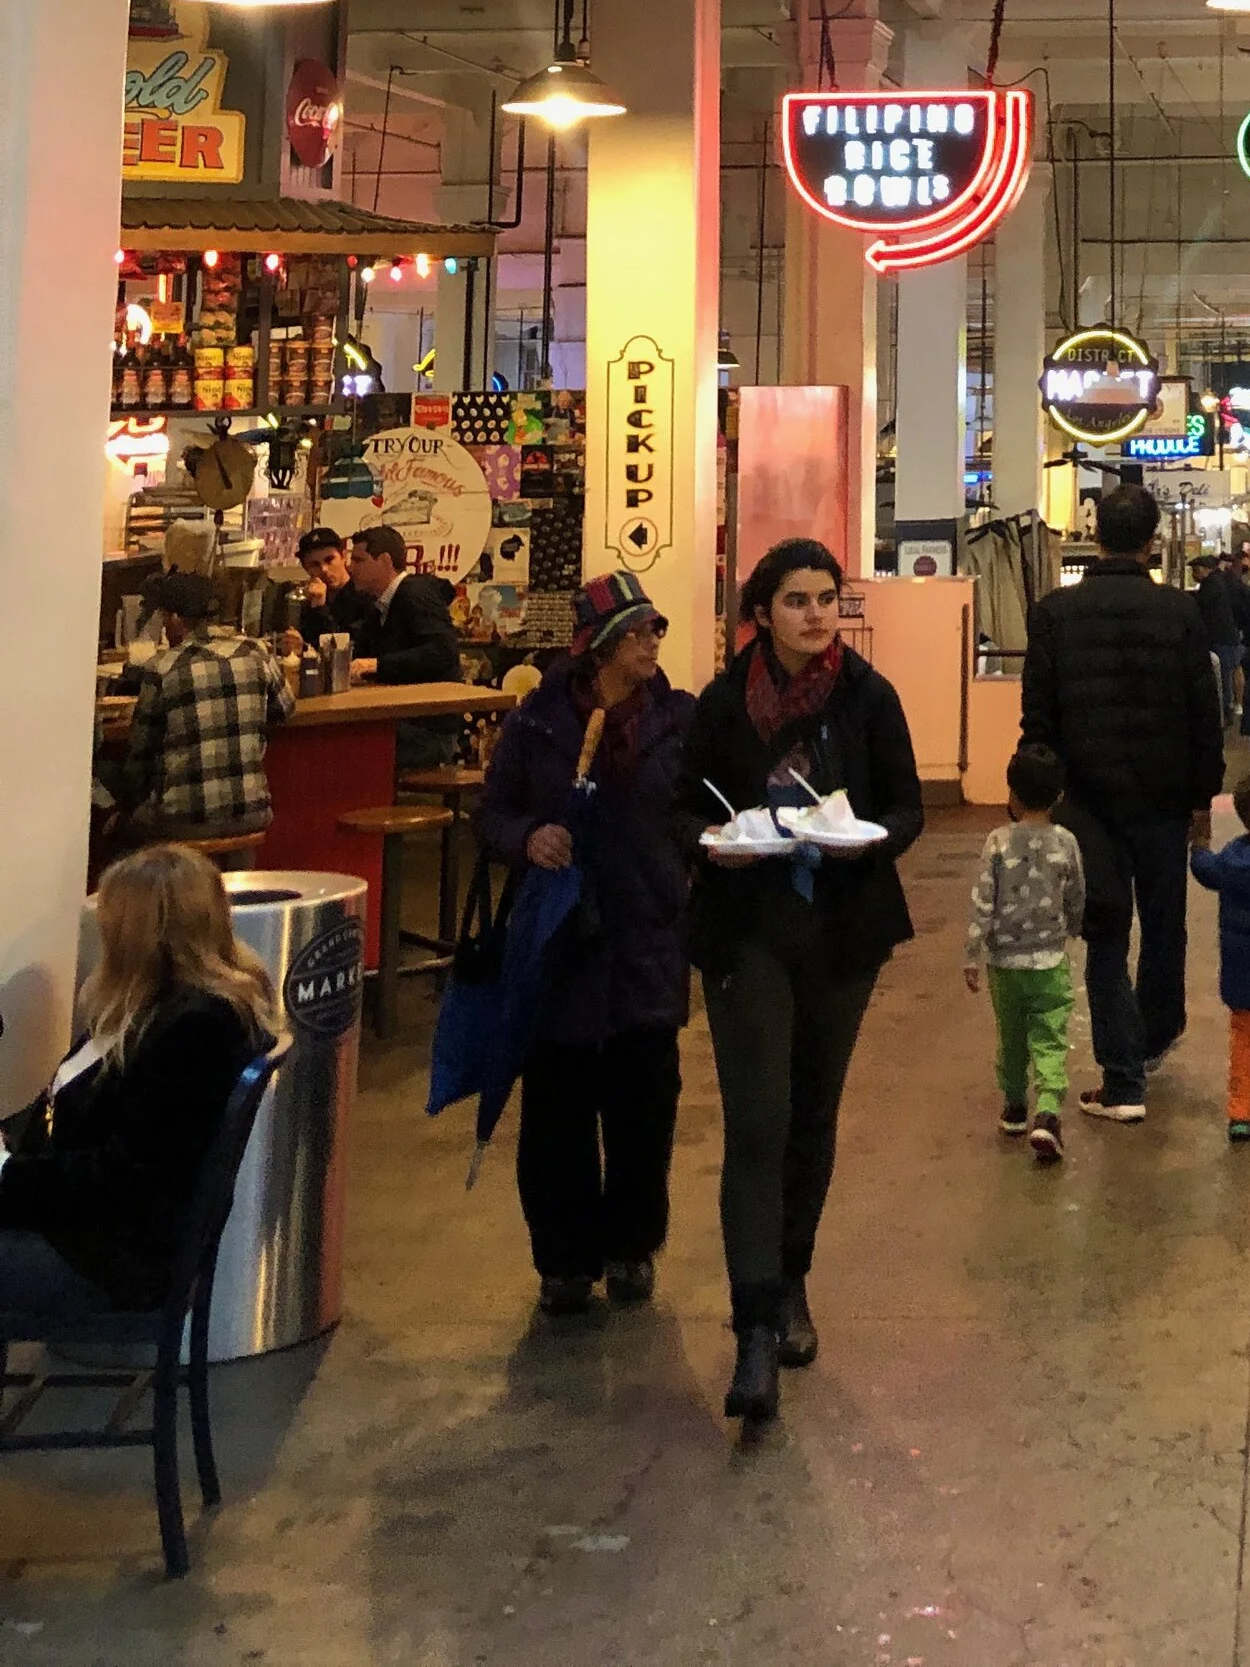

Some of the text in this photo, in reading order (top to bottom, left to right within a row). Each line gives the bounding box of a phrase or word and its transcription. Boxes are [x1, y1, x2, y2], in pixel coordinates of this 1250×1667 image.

[125, 50, 216, 115] old
[802, 103, 975, 135] FILIPINO
[123, 118, 225, 169] ER
[844, 138, 935, 170] RICE
[823, 174, 950, 206] BOWLS
[409, 436, 444, 454] OUR
[625, 360, 655, 508] PICKUP
